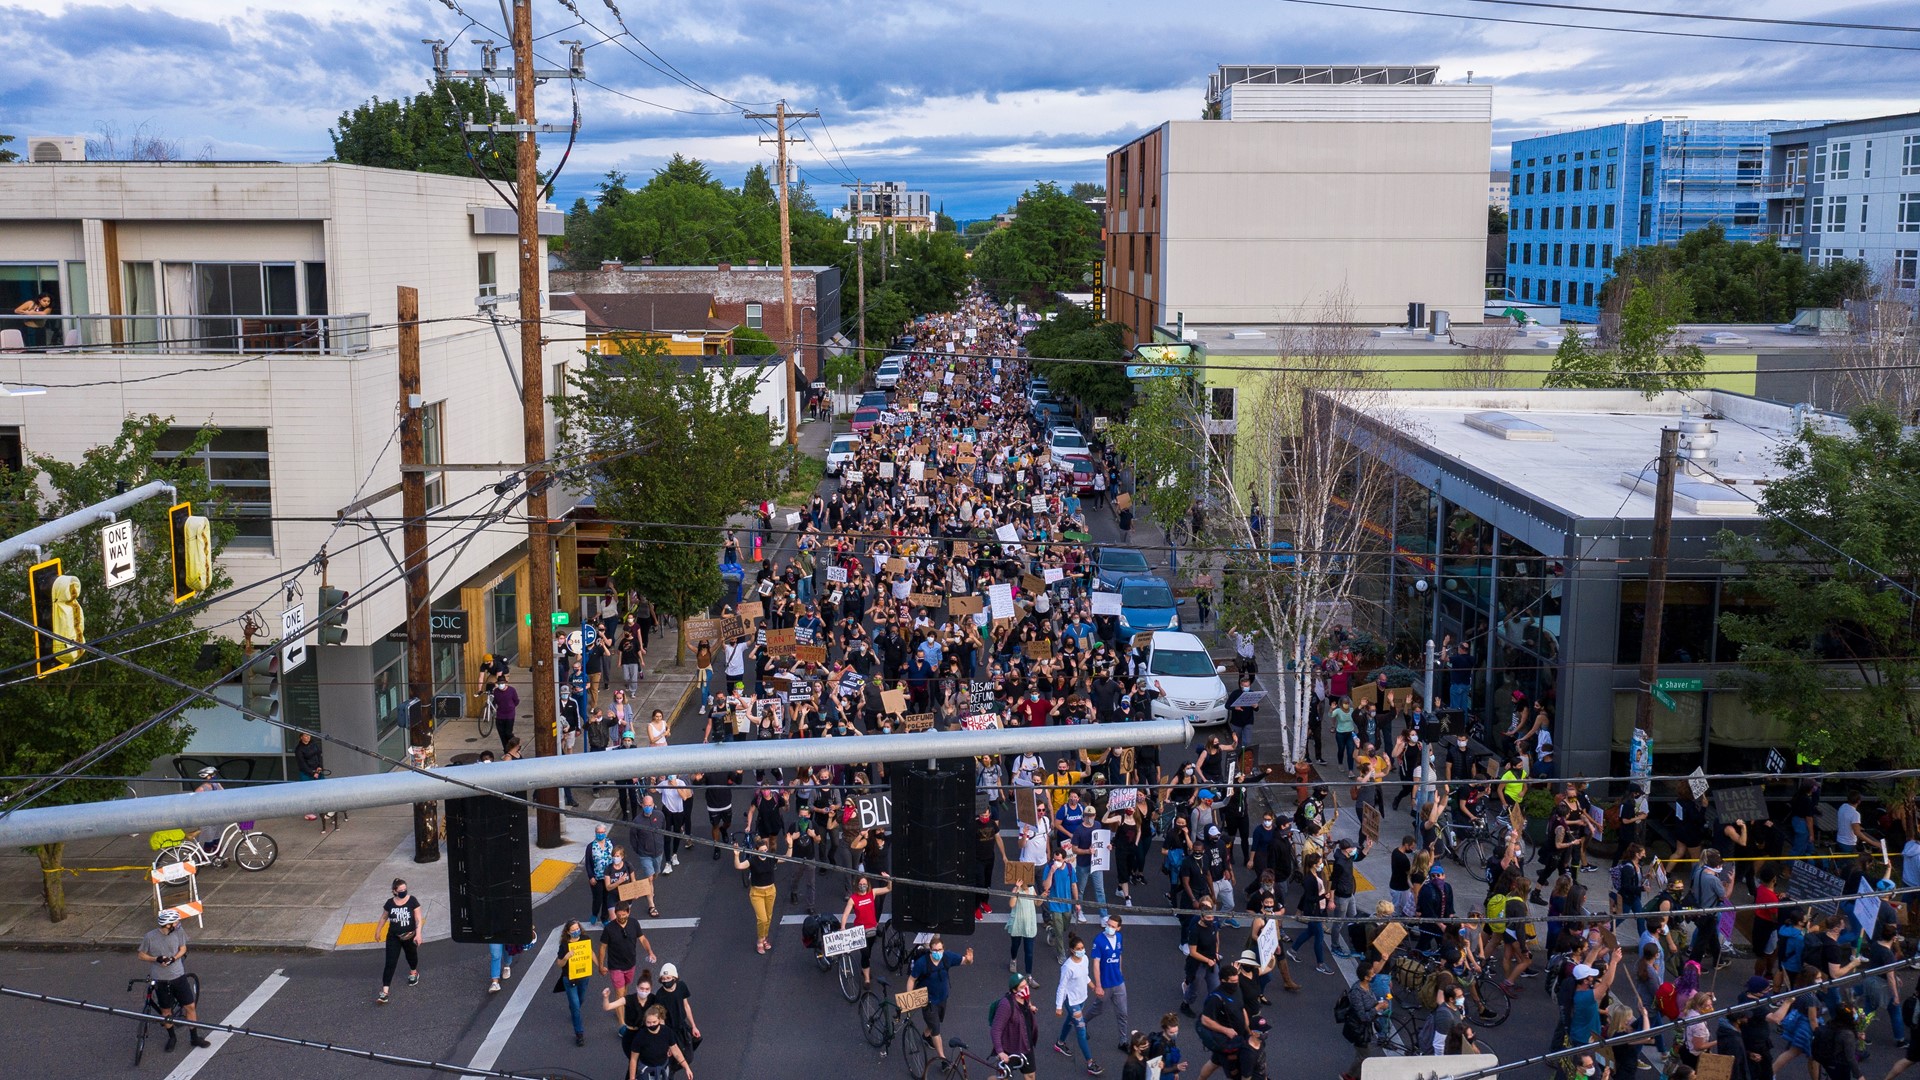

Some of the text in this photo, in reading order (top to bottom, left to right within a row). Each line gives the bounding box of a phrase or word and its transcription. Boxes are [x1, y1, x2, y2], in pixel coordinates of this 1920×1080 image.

[108, 526, 128, 544] ONE
[109, 542, 128, 560] WAY
[286, 610, 301, 629] ONE
[430, 615, 461, 633] ptic
[721, 618, 738, 627] BLACK
[724, 628, 743, 638] MATTER
[768, 635, 793, 644] CAN'T
[769, 645, 796, 655] BREATHE
[971, 682, 995, 692] DISARM
[970, 692, 994, 703] DEFUND
[907, 713, 934, 722] DEFUND
[907, 721, 934, 729] POLICE
[1718, 788, 1754, 801] BLACK
[1725, 800, 1758, 812] LIVES
[1006, 862, 1034, 881] BLM
[1793, 860, 1817, 875] KILLED
[1819, 871, 1828, 880] BY
[897, 993, 914, 1010] NO
